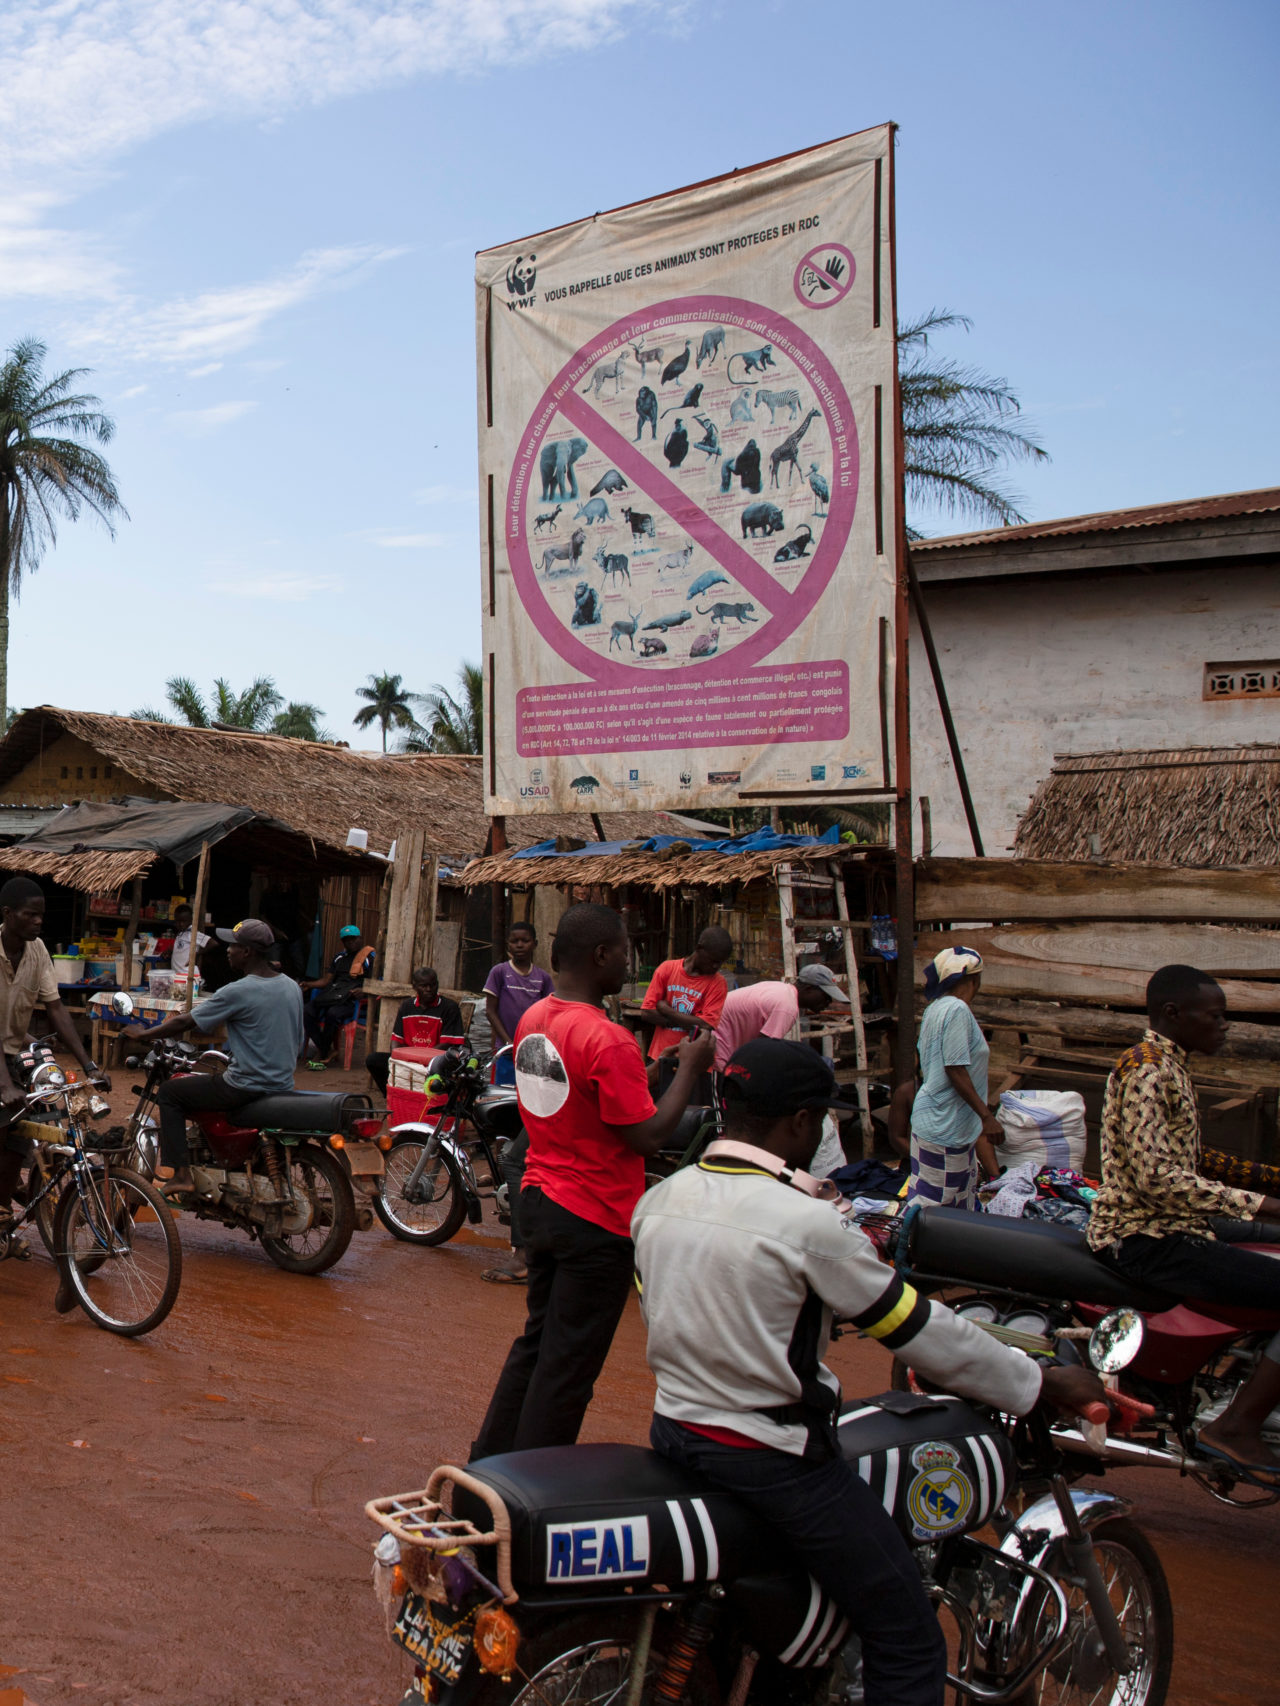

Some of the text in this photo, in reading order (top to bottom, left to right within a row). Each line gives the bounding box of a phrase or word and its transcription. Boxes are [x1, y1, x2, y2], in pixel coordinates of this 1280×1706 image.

[545, 214, 820, 303] VOUS RAPPELLE QUE CES ANIMAUX SONT PROTEGES EN RDC
[507, 295, 537, 312] WWF
[631, 322, 650, 335] leur
[652, 308, 745, 328] commercialisation
[745, 318, 768, 335] sont
[621, 331, 631, 342] et
[568, 338, 619, 383] braconnage
[553, 380, 571, 401] leur
[809, 368, 846, 434] sanctionnés
[533, 402, 558, 437] chasse,
[523, 436, 537, 459] leur
[834, 434, 848, 455] par
[840, 456, 852, 469] la
[510, 461, 530, 512] détention,
[840, 471, 852, 487] loi
[510, 515, 519, 538] Leur
[520, 785, 550, 796] USAID
[577, 786, 594, 795] CARPE
[549, 1524, 646, 1577] REAL
